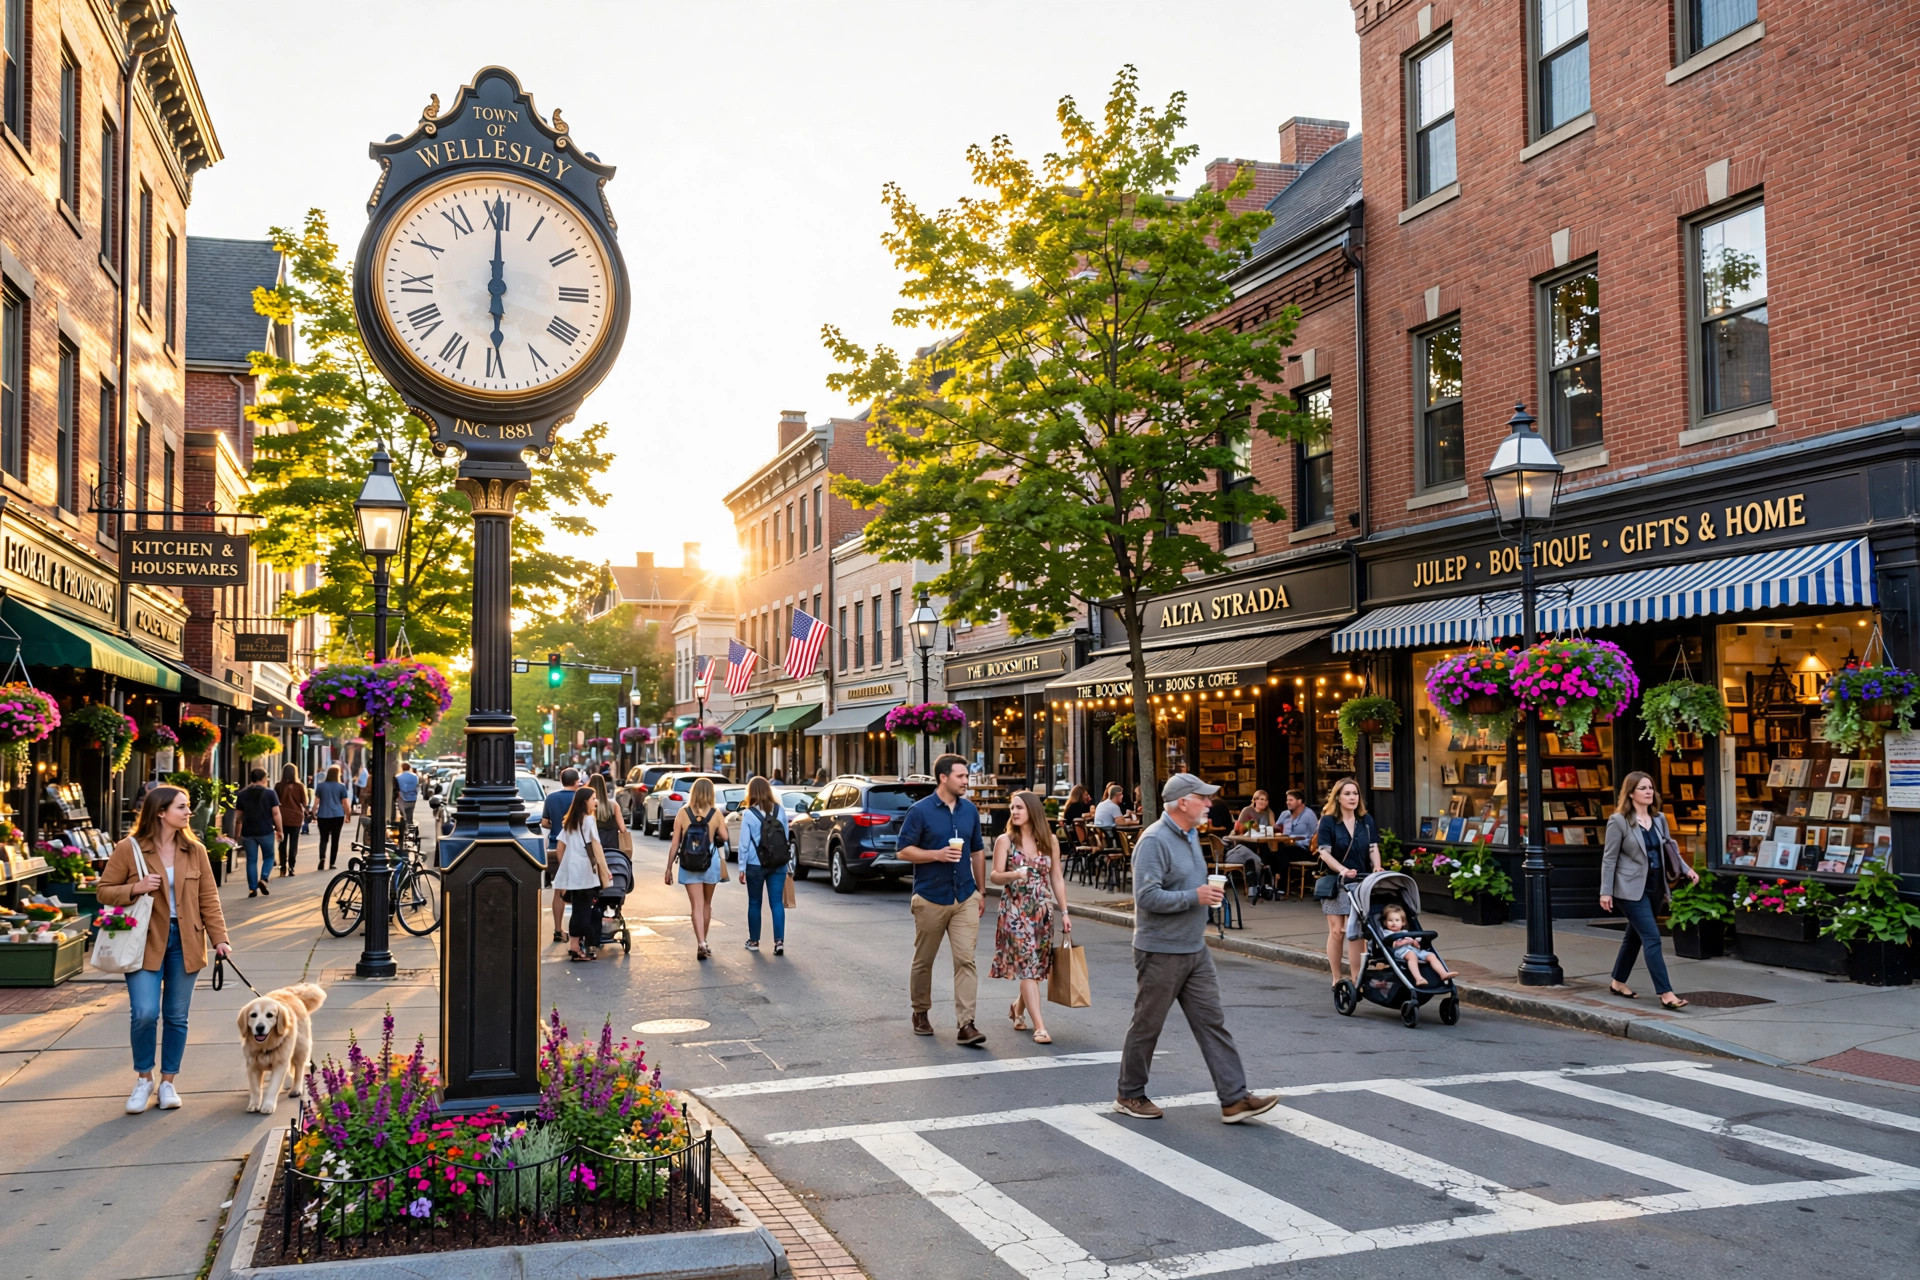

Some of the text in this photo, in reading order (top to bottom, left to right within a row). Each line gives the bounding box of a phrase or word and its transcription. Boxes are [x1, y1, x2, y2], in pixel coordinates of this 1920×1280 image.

[473, 106, 519, 123] TOWN
[487, 123, 507, 136] OF
[415, 138, 572, 181] WELLESLEY
[440, 204, 474, 240] XI
[410, 232, 445, 260] X
[558, 286, 589, 304] III
[453, 418, 534, 439] INC. 1881
[131, 540, 234, 557] KITCHEN &
[1413, 555, 1468, 588] JULEP
[1619, 515, 1690, 554] GIFTS
[1698, 512, 1717, 542] &
[1725, 493, 1806, 537] HOME
[6, 537, 50, 586] FLORAL
[53, 561, 61, 592] &
[131, 561, 238, 576] HOUSEWARES
[1160, 585, 1290, 629] ALTA STRADA
[1077, 685, 1093, 698] THE
[1166, 676, 1196, 692] BOOKS
[1198, 675, 1205, 689] &
